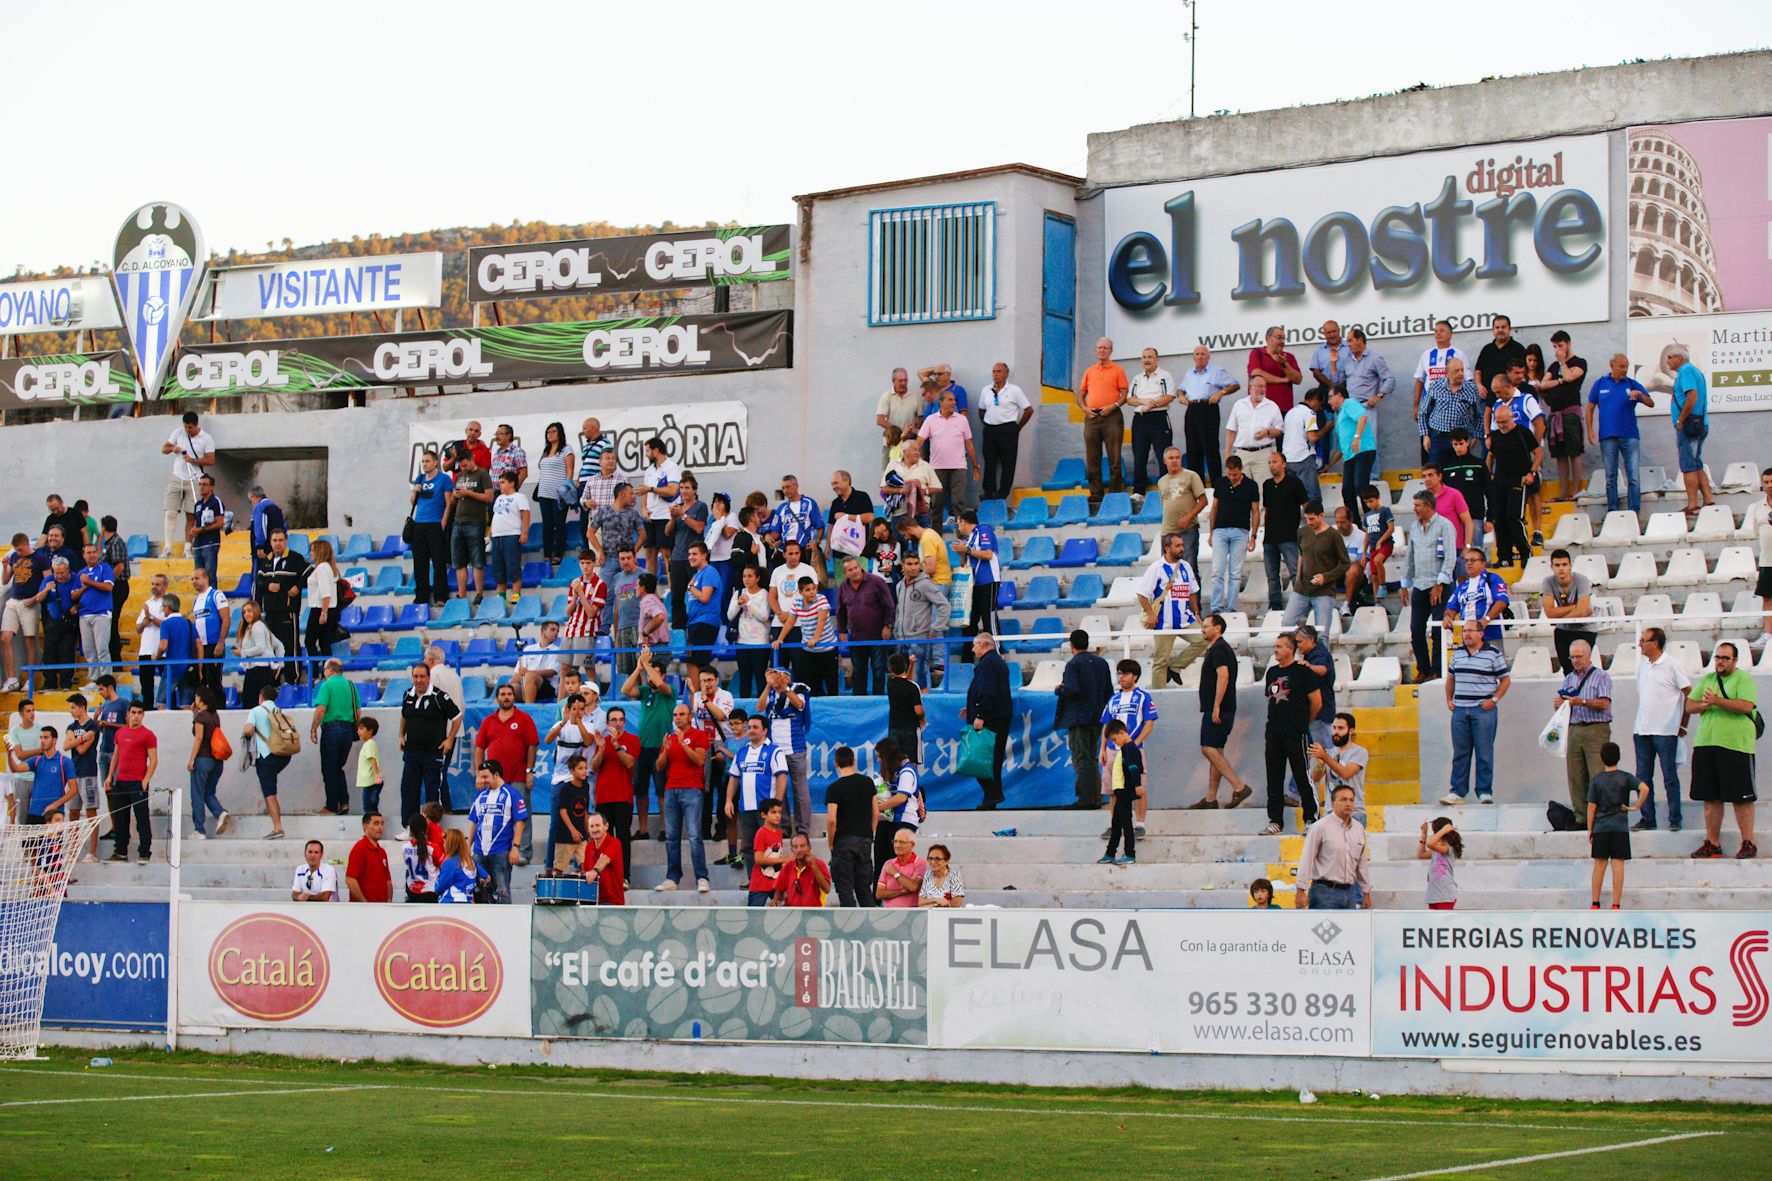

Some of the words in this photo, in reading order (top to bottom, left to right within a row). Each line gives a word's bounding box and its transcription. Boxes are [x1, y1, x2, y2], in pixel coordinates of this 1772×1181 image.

[1466, 151, 1565, 198] digital
[644, 234, 776, 281] CEROL
[1108, 190, 1200, 310] el
[1231, 175, 1603, 300] nostre
[143, 258, 189, 269] ALCOYANO
[477, 247, 602, 293] CEROL
[258, 263, 402, 310] VISITANTE
[582, 325, 711, 369] CEROL
[1712, 327, 1772, 344] Martí
[15, 360, 120, 400] CEROL
[176, 350, 289, 391] CEROL
[373, 338, 493, 381] CEROL
[1726, 393, 1752, 403] Santa
[406, 856, 429, 880] 14
[948, 918, 1154, 971] ELASA
[1180, 939, 1203, 952] Con
[1206, 939, 1217, 952] la
[1271, 940, 1287, 953] de
[1402, 927, 1524, 949] ENERGIAS
[1532, 927, 1697, 950] RENOVABLES
[217, 945, 316, 987] Catalá
[384, 950, 489, 992] Catalá
[600, 949, 675, 988] café
[818, 939, 917, 1011] BARSEL
[1189, 991, 1238, 1016] 965
[1247, 992, 1297, 1017] 330
[1304, 993, 1357, 1018] 894
[1400, 963, 1717, 1016] INDUSTRIAS
[1194, 1021, 1354, 1043] www.elasa.com
[1402, 1028, 1702, 1054] www.seguirenovables.es
